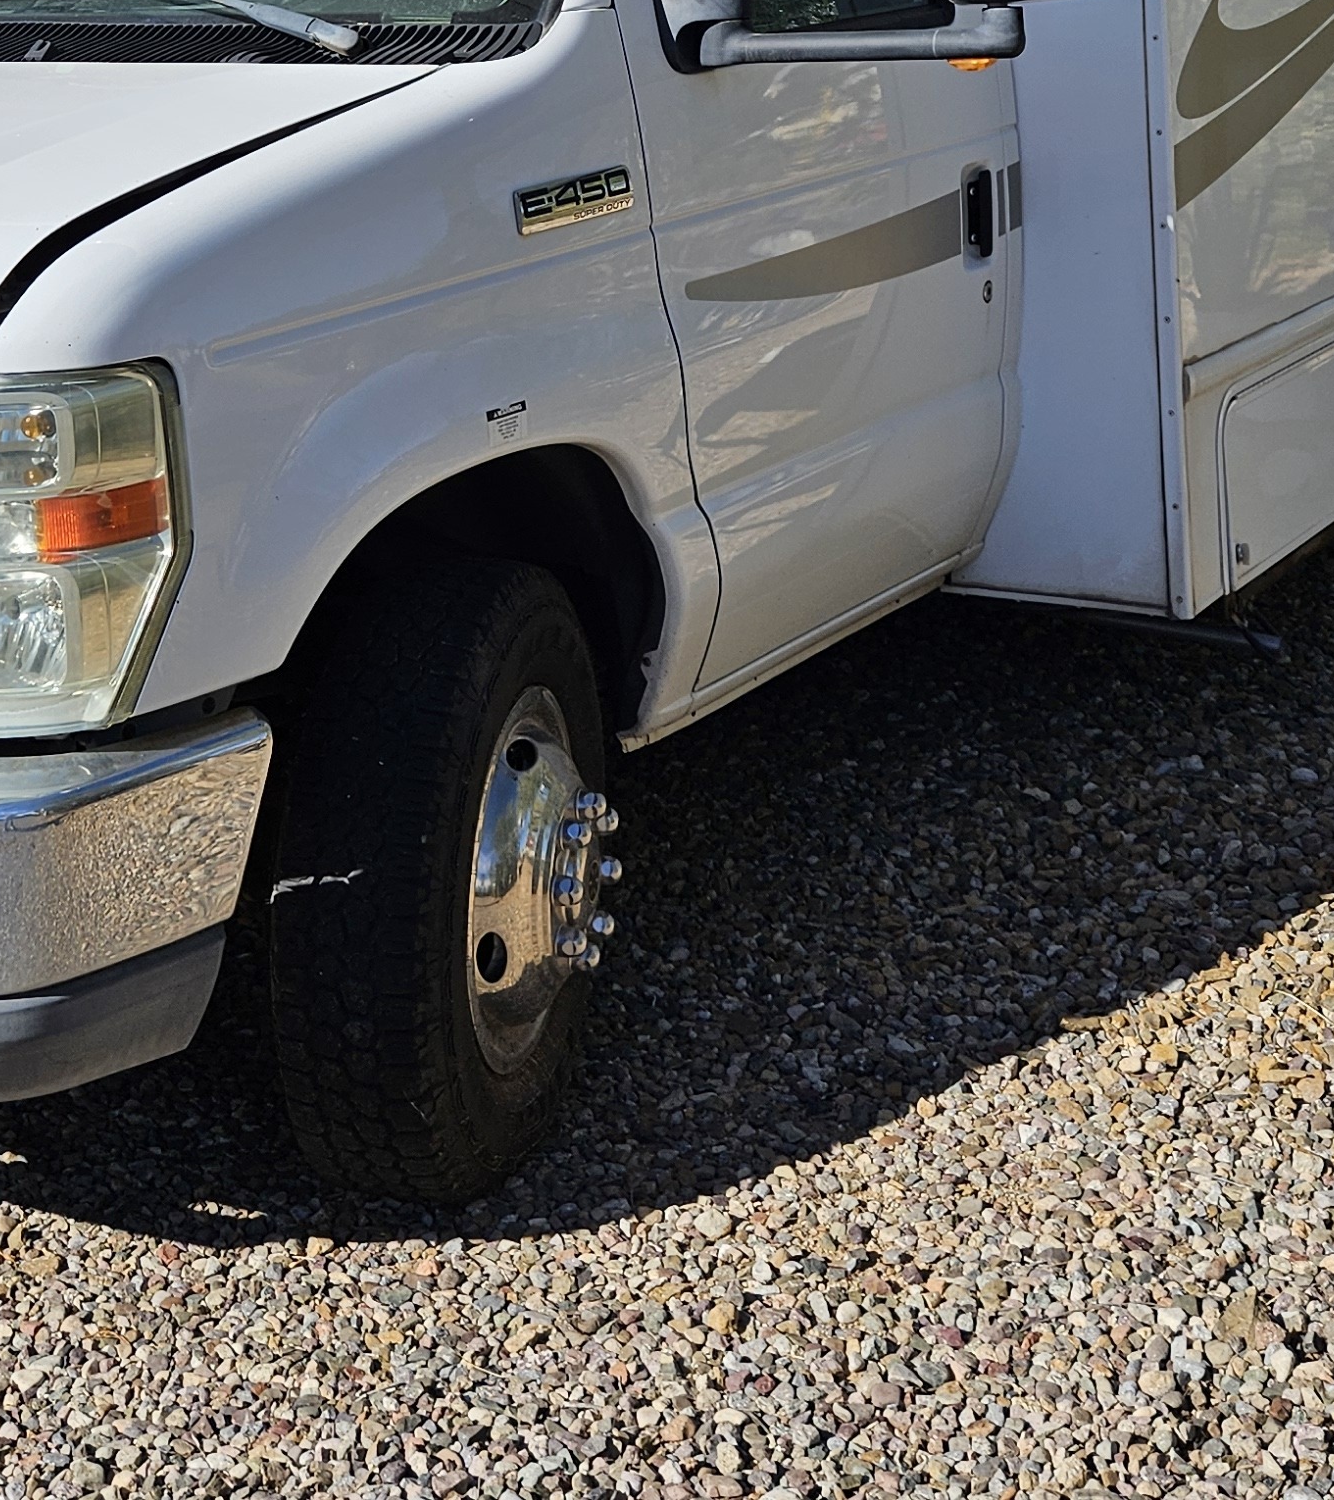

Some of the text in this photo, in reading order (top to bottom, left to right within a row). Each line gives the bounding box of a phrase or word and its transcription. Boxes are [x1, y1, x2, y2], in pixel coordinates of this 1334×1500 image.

[520, 169, 630, 218] E-450
[573, 198, 631, 220] SUPER DUTY
